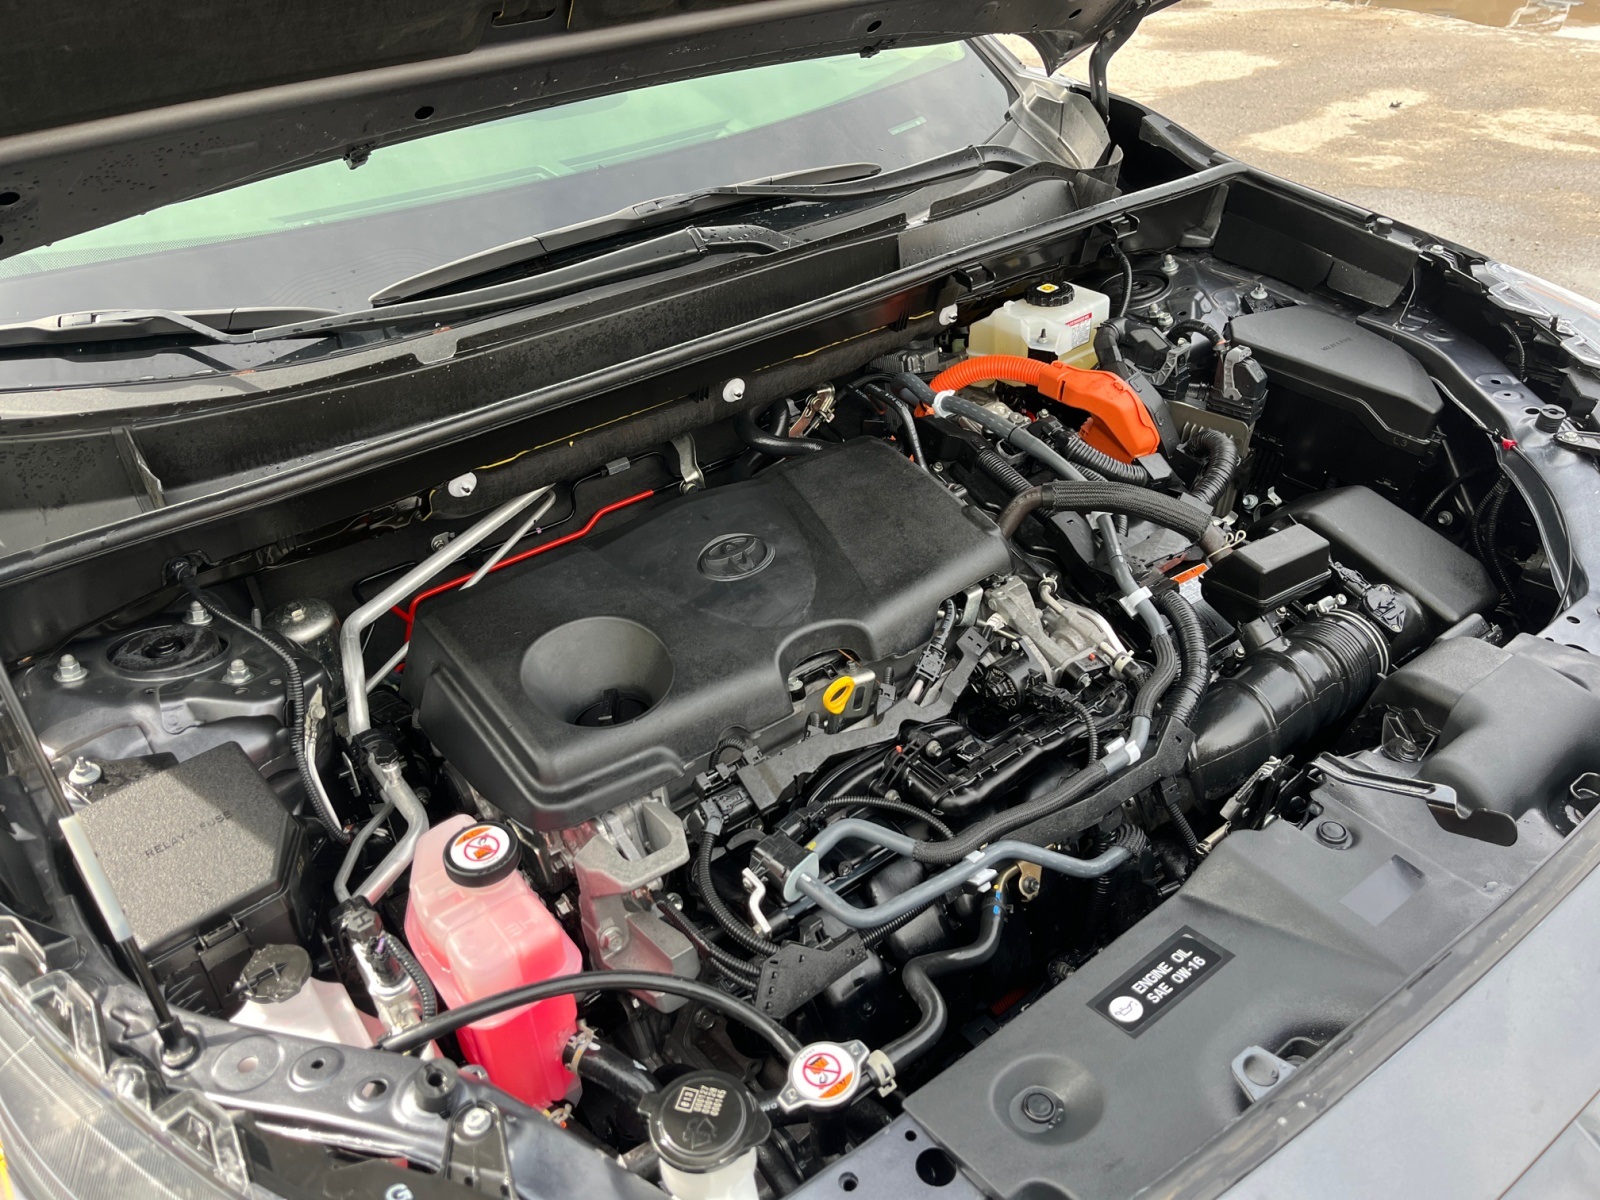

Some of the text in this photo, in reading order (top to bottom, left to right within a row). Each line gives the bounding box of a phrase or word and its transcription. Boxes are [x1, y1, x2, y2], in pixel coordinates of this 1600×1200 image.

[145, 833, 186, 858] RELAY
[1131, 948, 1194, 995] ENGINE OIL
[1146, 955, 1206, 1004] SAE 0W-16
